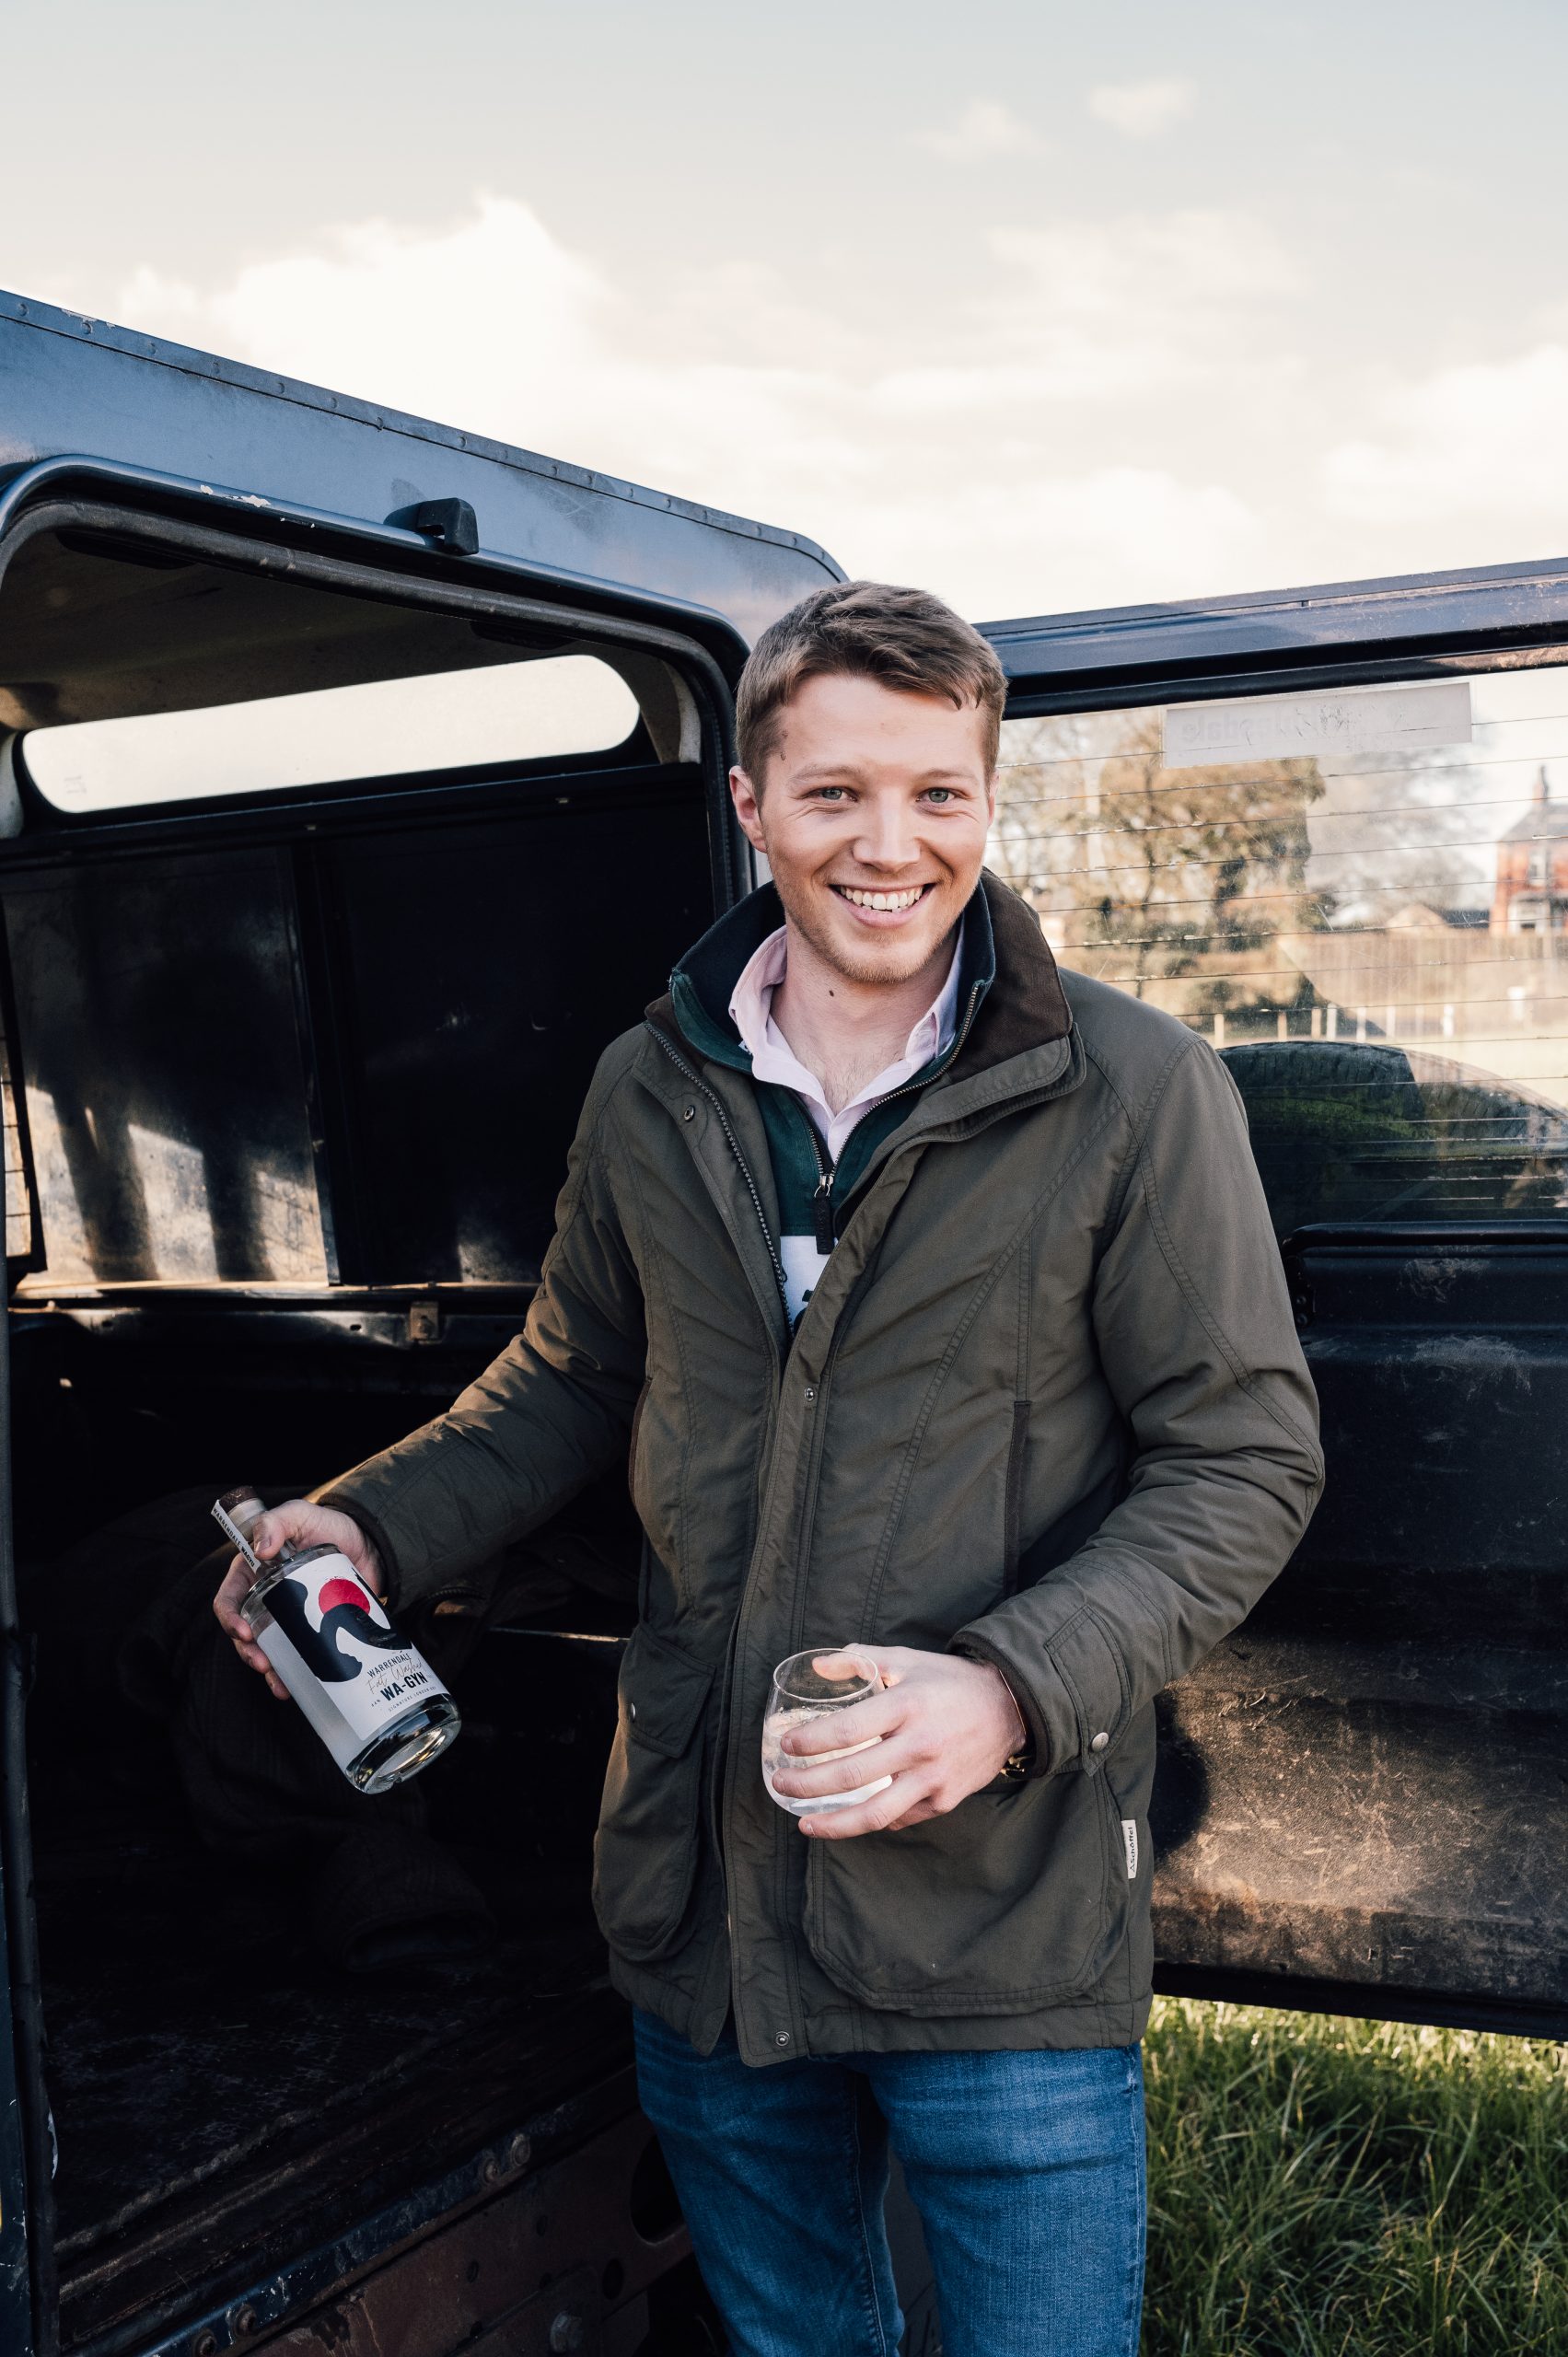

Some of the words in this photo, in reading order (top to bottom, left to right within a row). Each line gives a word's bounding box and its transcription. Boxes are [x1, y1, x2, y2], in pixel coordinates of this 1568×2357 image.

[213, 1507, 241, 1547] WARRENDALE
[241, 1546, 255, 1568] WAGYU
[367, 1654, 412, 1678] WARRENDALE
[380, 1672, 428, 1701] WA-GYN
